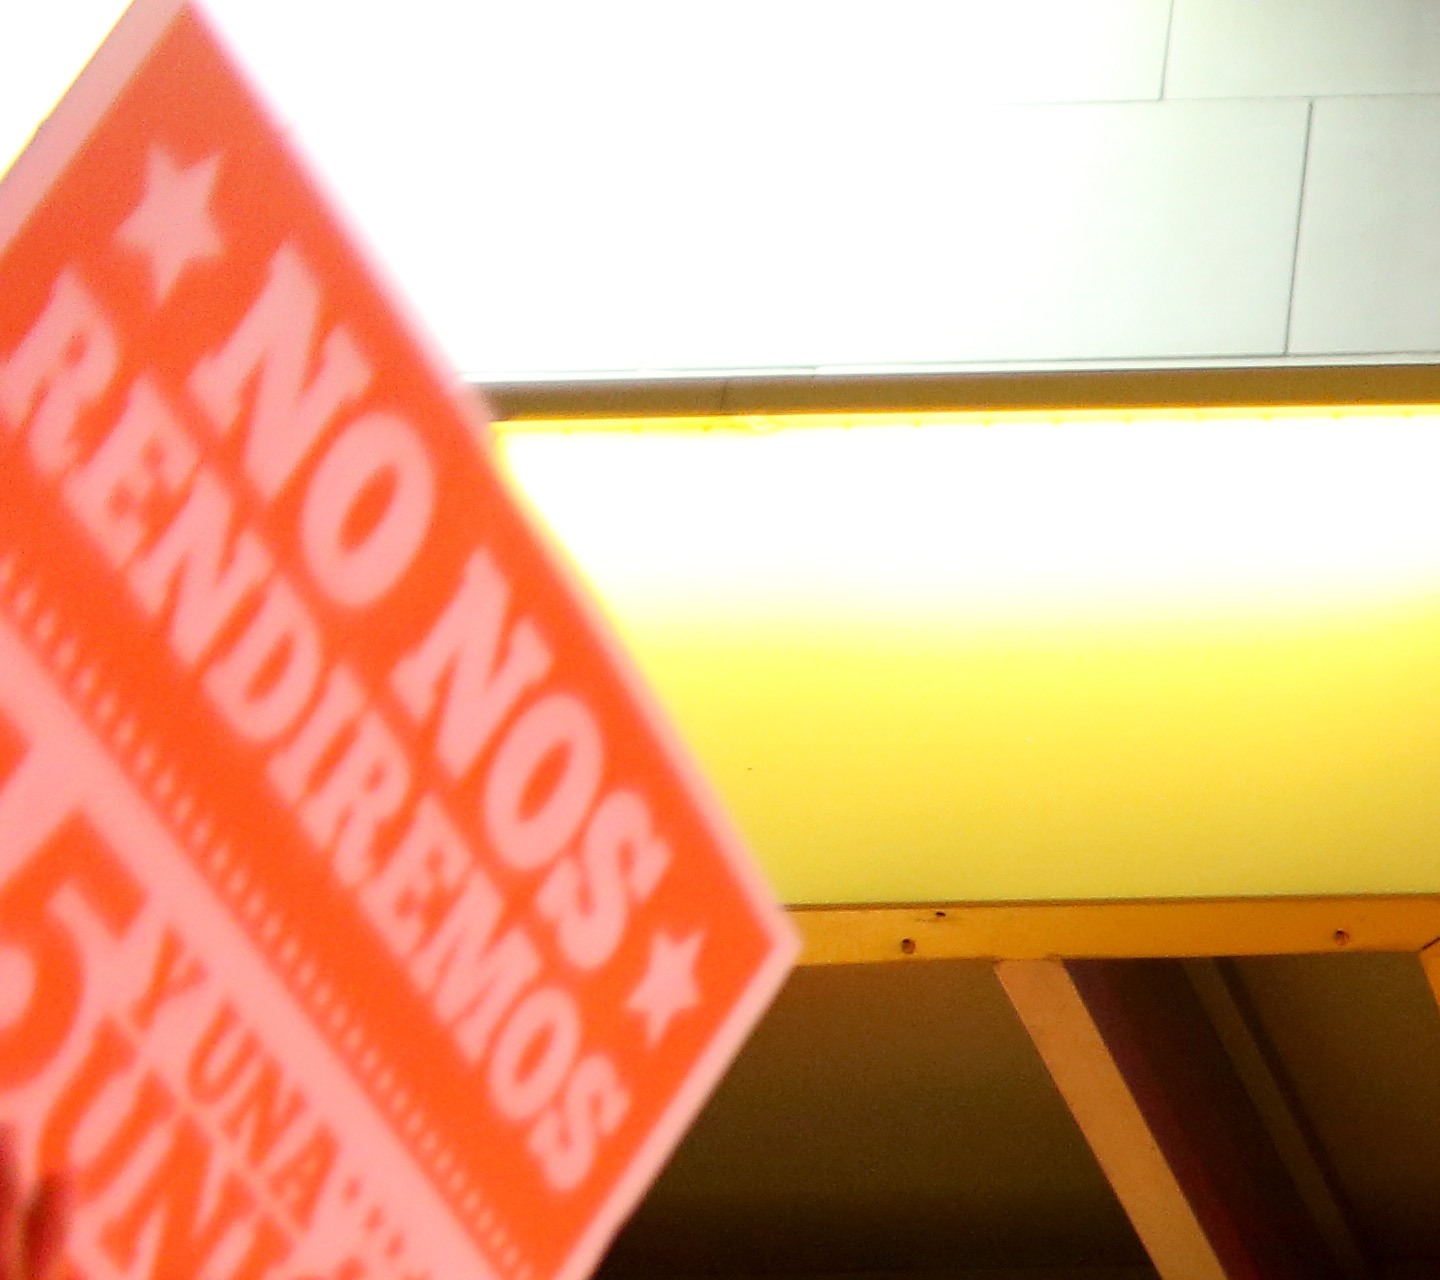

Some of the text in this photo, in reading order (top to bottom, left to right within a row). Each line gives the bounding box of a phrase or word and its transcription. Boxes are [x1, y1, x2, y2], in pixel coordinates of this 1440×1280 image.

[0, 266, 629, 1192] RENDIREMOS
[189, 241, 669, 971] NO NOS
[187, 1000, 342, 1235] UNA
